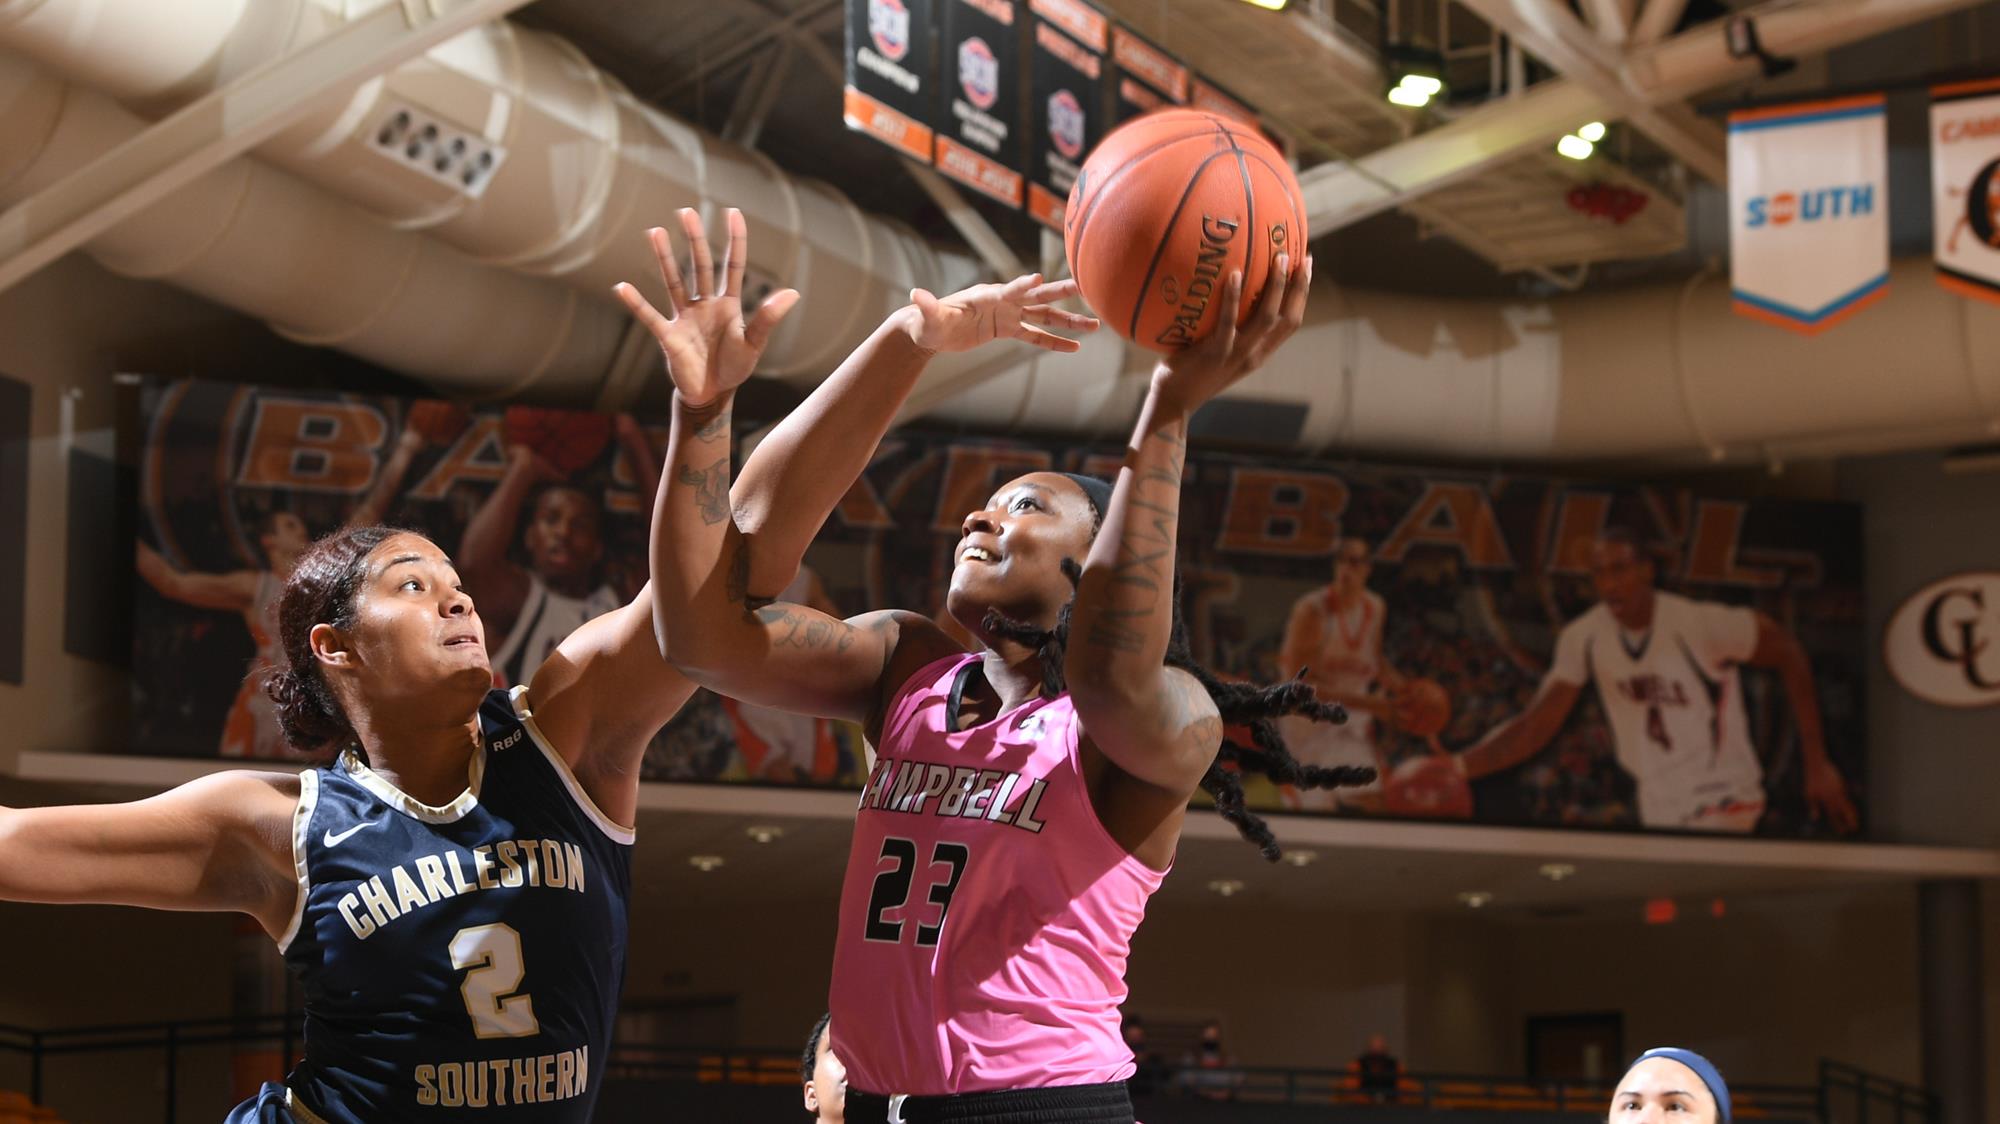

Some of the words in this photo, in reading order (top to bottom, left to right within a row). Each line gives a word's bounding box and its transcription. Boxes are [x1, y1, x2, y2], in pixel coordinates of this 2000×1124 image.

[1745, 182, 1874, 229] SOUTH
[492, 729, 522, 752] RBG
[337, 839, 585, 940] CHARLESTON
[864, 834, 969, 948] 23
[448, 922, 541, 1039] 2
[415, 1045, 589, 1108] SOUTHERN
